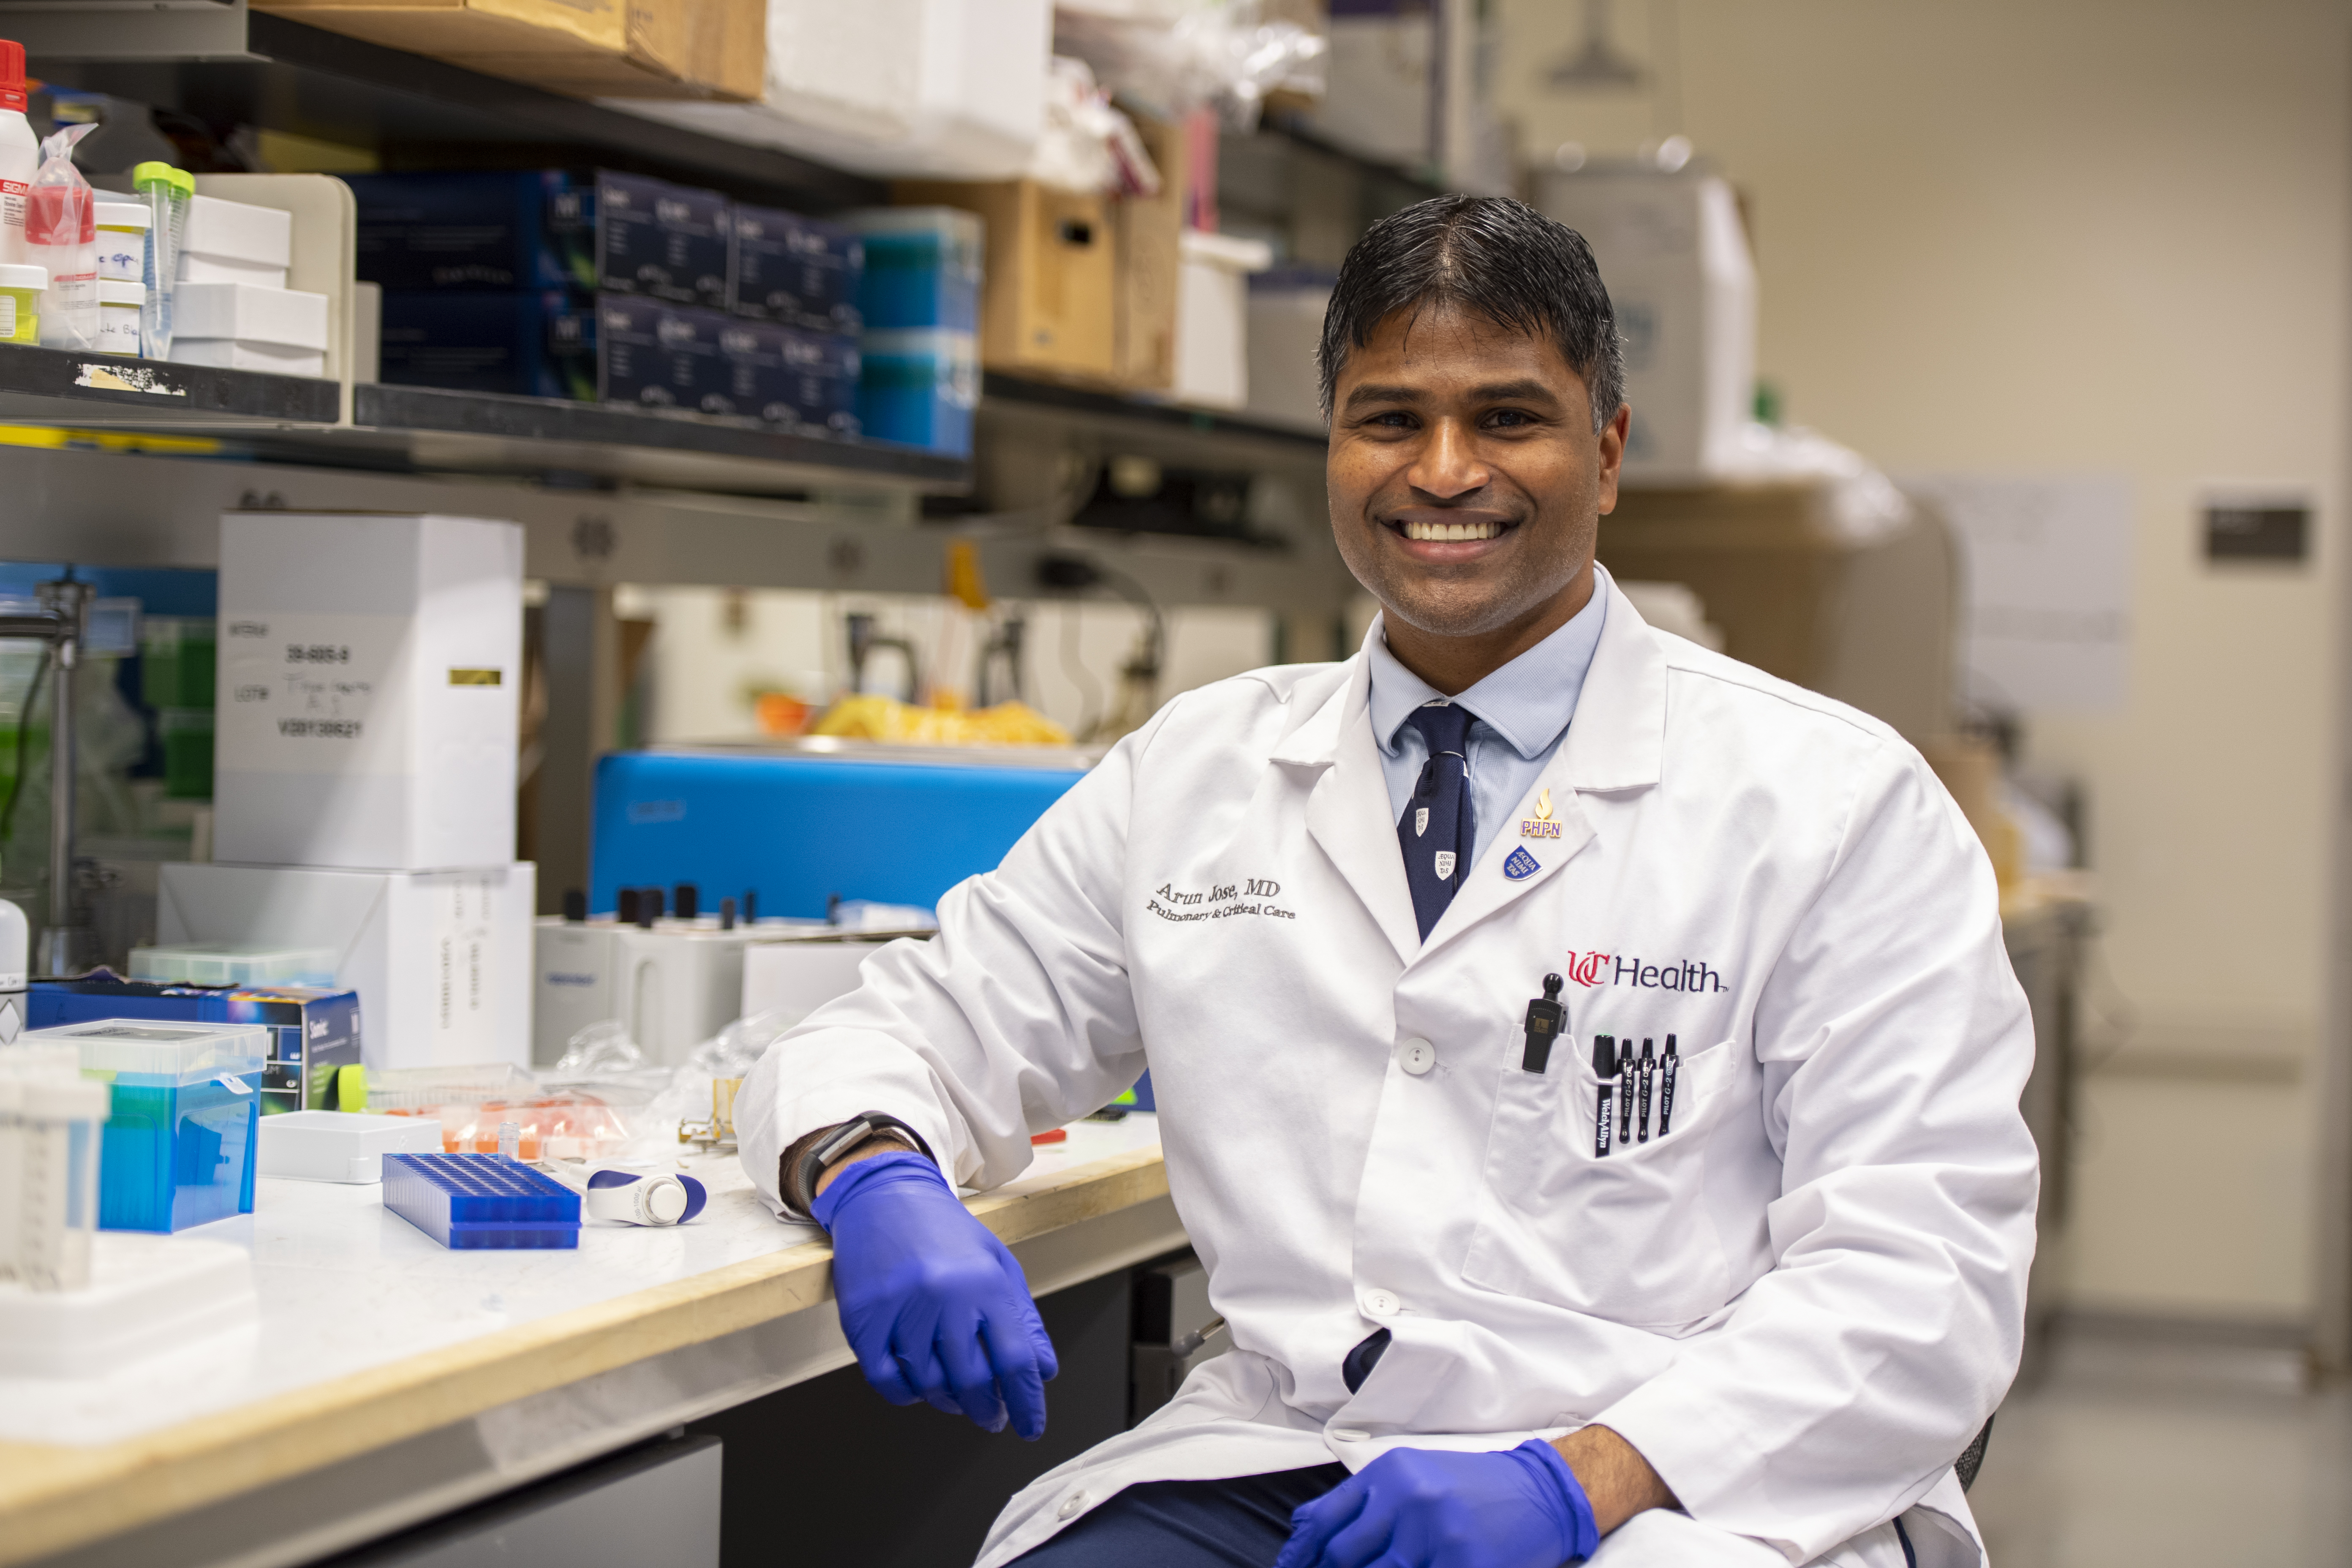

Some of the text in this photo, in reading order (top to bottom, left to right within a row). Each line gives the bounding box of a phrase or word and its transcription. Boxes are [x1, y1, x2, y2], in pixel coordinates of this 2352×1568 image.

[1522, 820, 1561, 837] PHPN
[1507, 863, 1520, 876] TAS
[1511, 856, 1529, 874] NIMI
[1516, 851, 1536, 871] ÆQUA
[1156, 878, 1280, 905] Arun Jose, MD
[1146, 900, 1296, 922] Pulmonary & Critical Care
[1568, 950, 1610, 988] UC
[1614, 955, 1719, 992] Health
[634, 1193, 642, 1219] 100-1000
